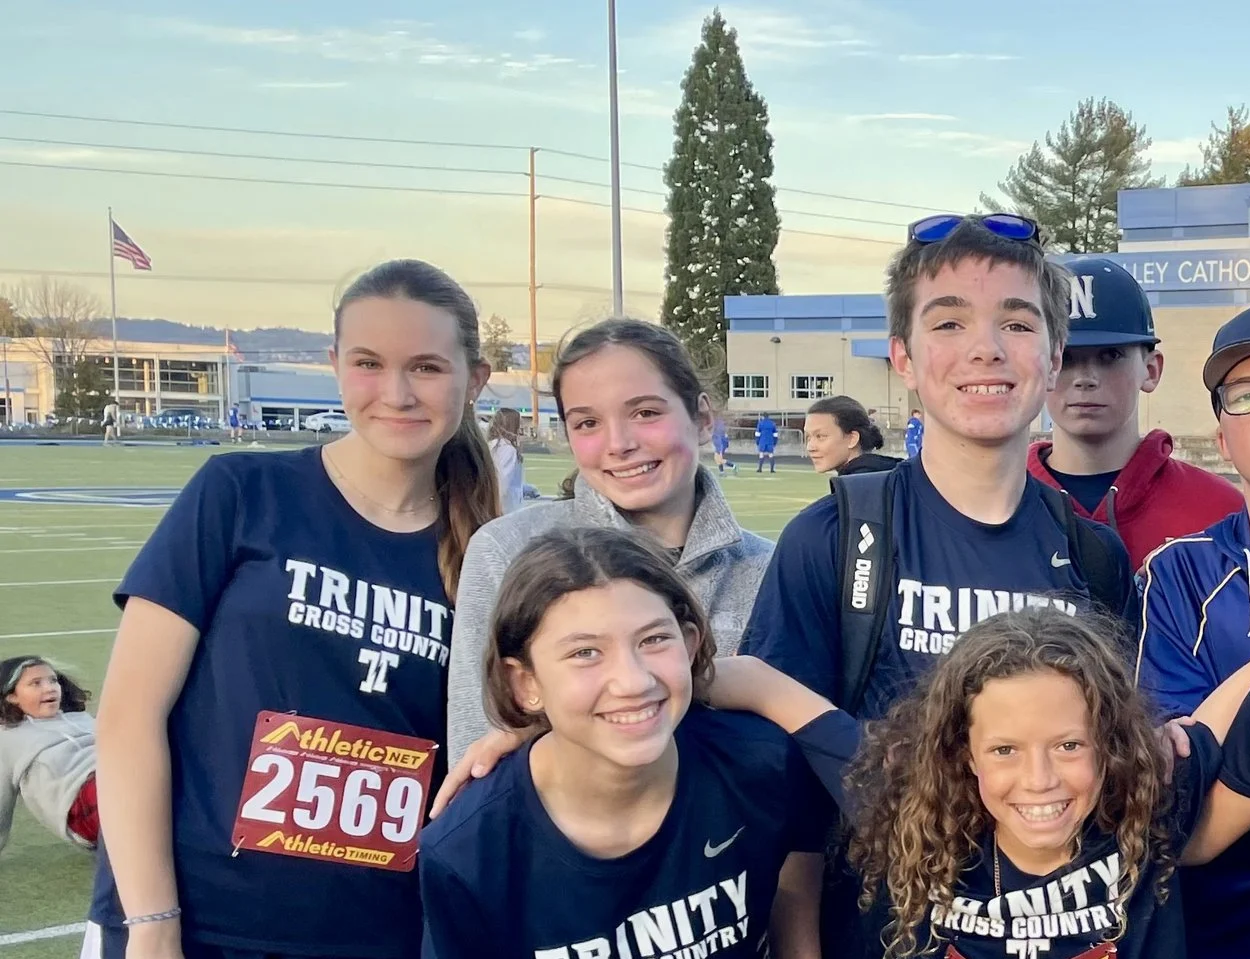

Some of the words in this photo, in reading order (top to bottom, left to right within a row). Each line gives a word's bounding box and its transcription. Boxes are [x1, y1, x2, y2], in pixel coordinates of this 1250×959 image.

[1068, 275, 1097, 319] N
[285, 559, 455, 641] TRINIT
[851, 558, 872, 609] arena
[288, 601, 365, 639] CROSS
[371, 624, 449, 667] COUNTR
[899, 627, 962, 656] CROS
[241, 753, 424, 843] 2569
[348, 850, 389, 863] TIMING
